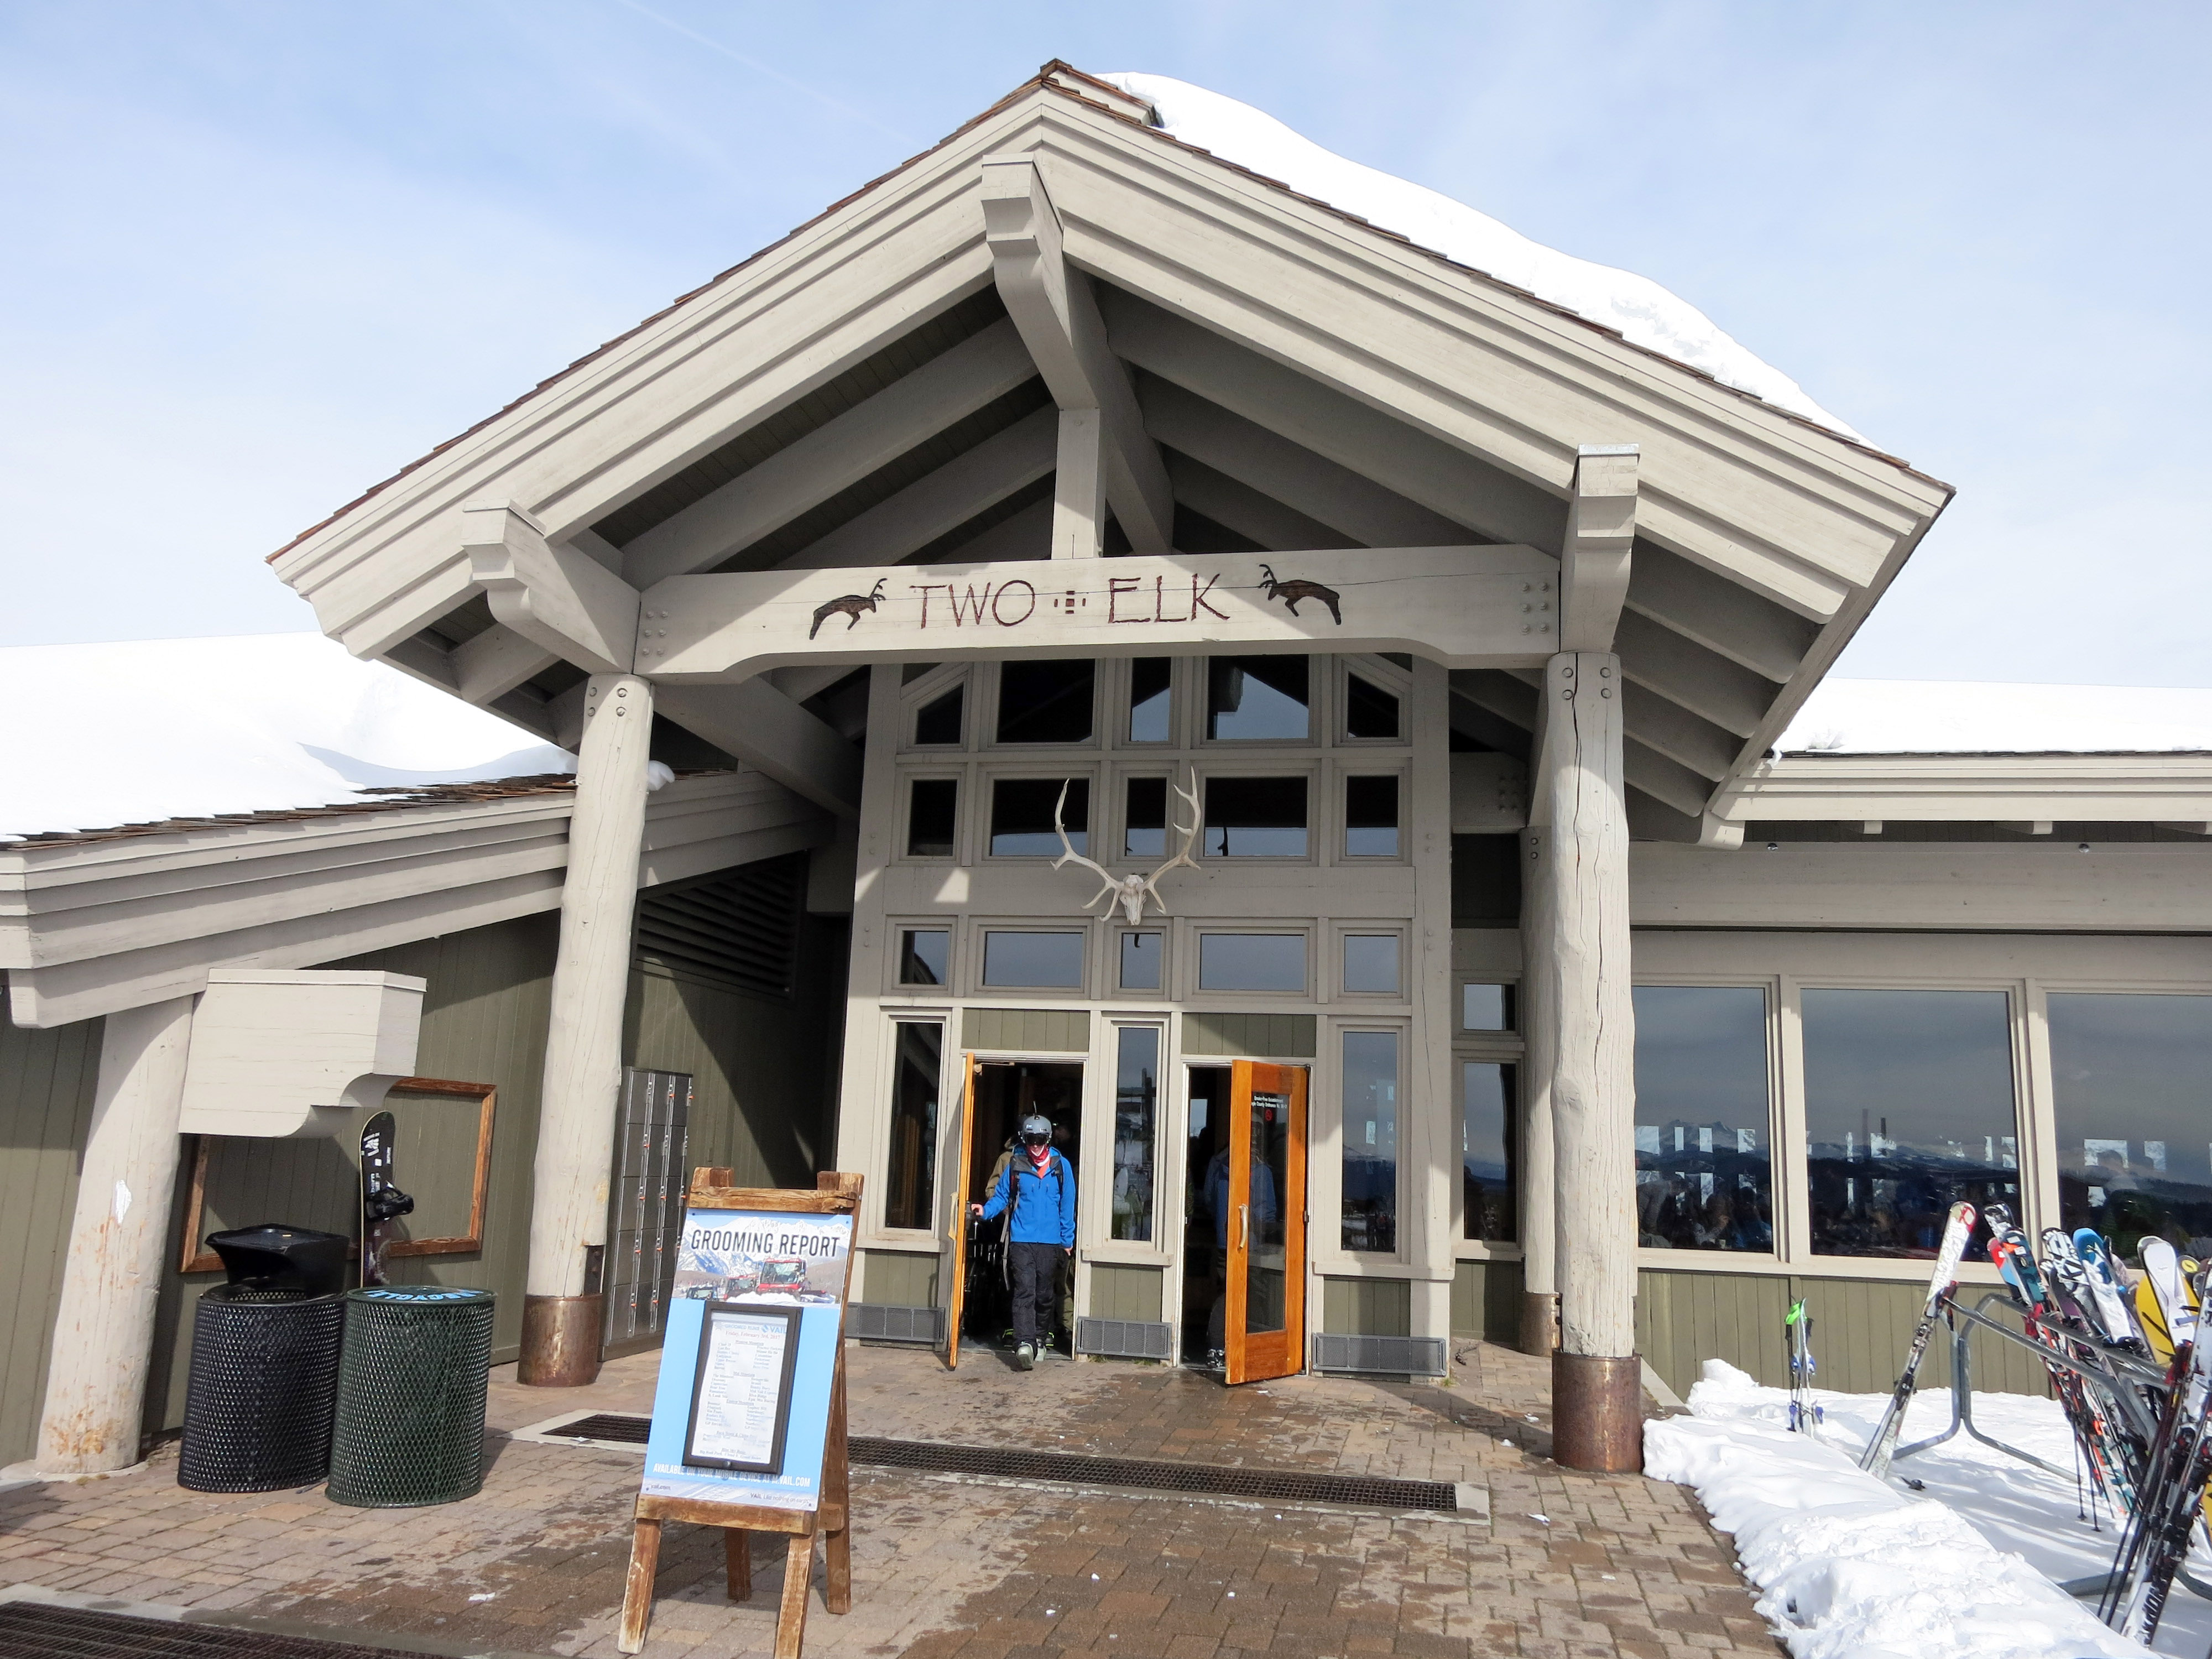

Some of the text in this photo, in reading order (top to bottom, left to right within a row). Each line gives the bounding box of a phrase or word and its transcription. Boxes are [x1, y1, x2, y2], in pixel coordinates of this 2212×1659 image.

[909, 573, 1230, 629] TWO ELK
[691, 1229, 840, 1258] GROOMING REPORT
[363, 1288, 483, 1300] RECYCLE
[653, 1463, 811, 1487] AVAILABLE ON YOUR MOBILE DEVICE AT M.VAIL.COM
